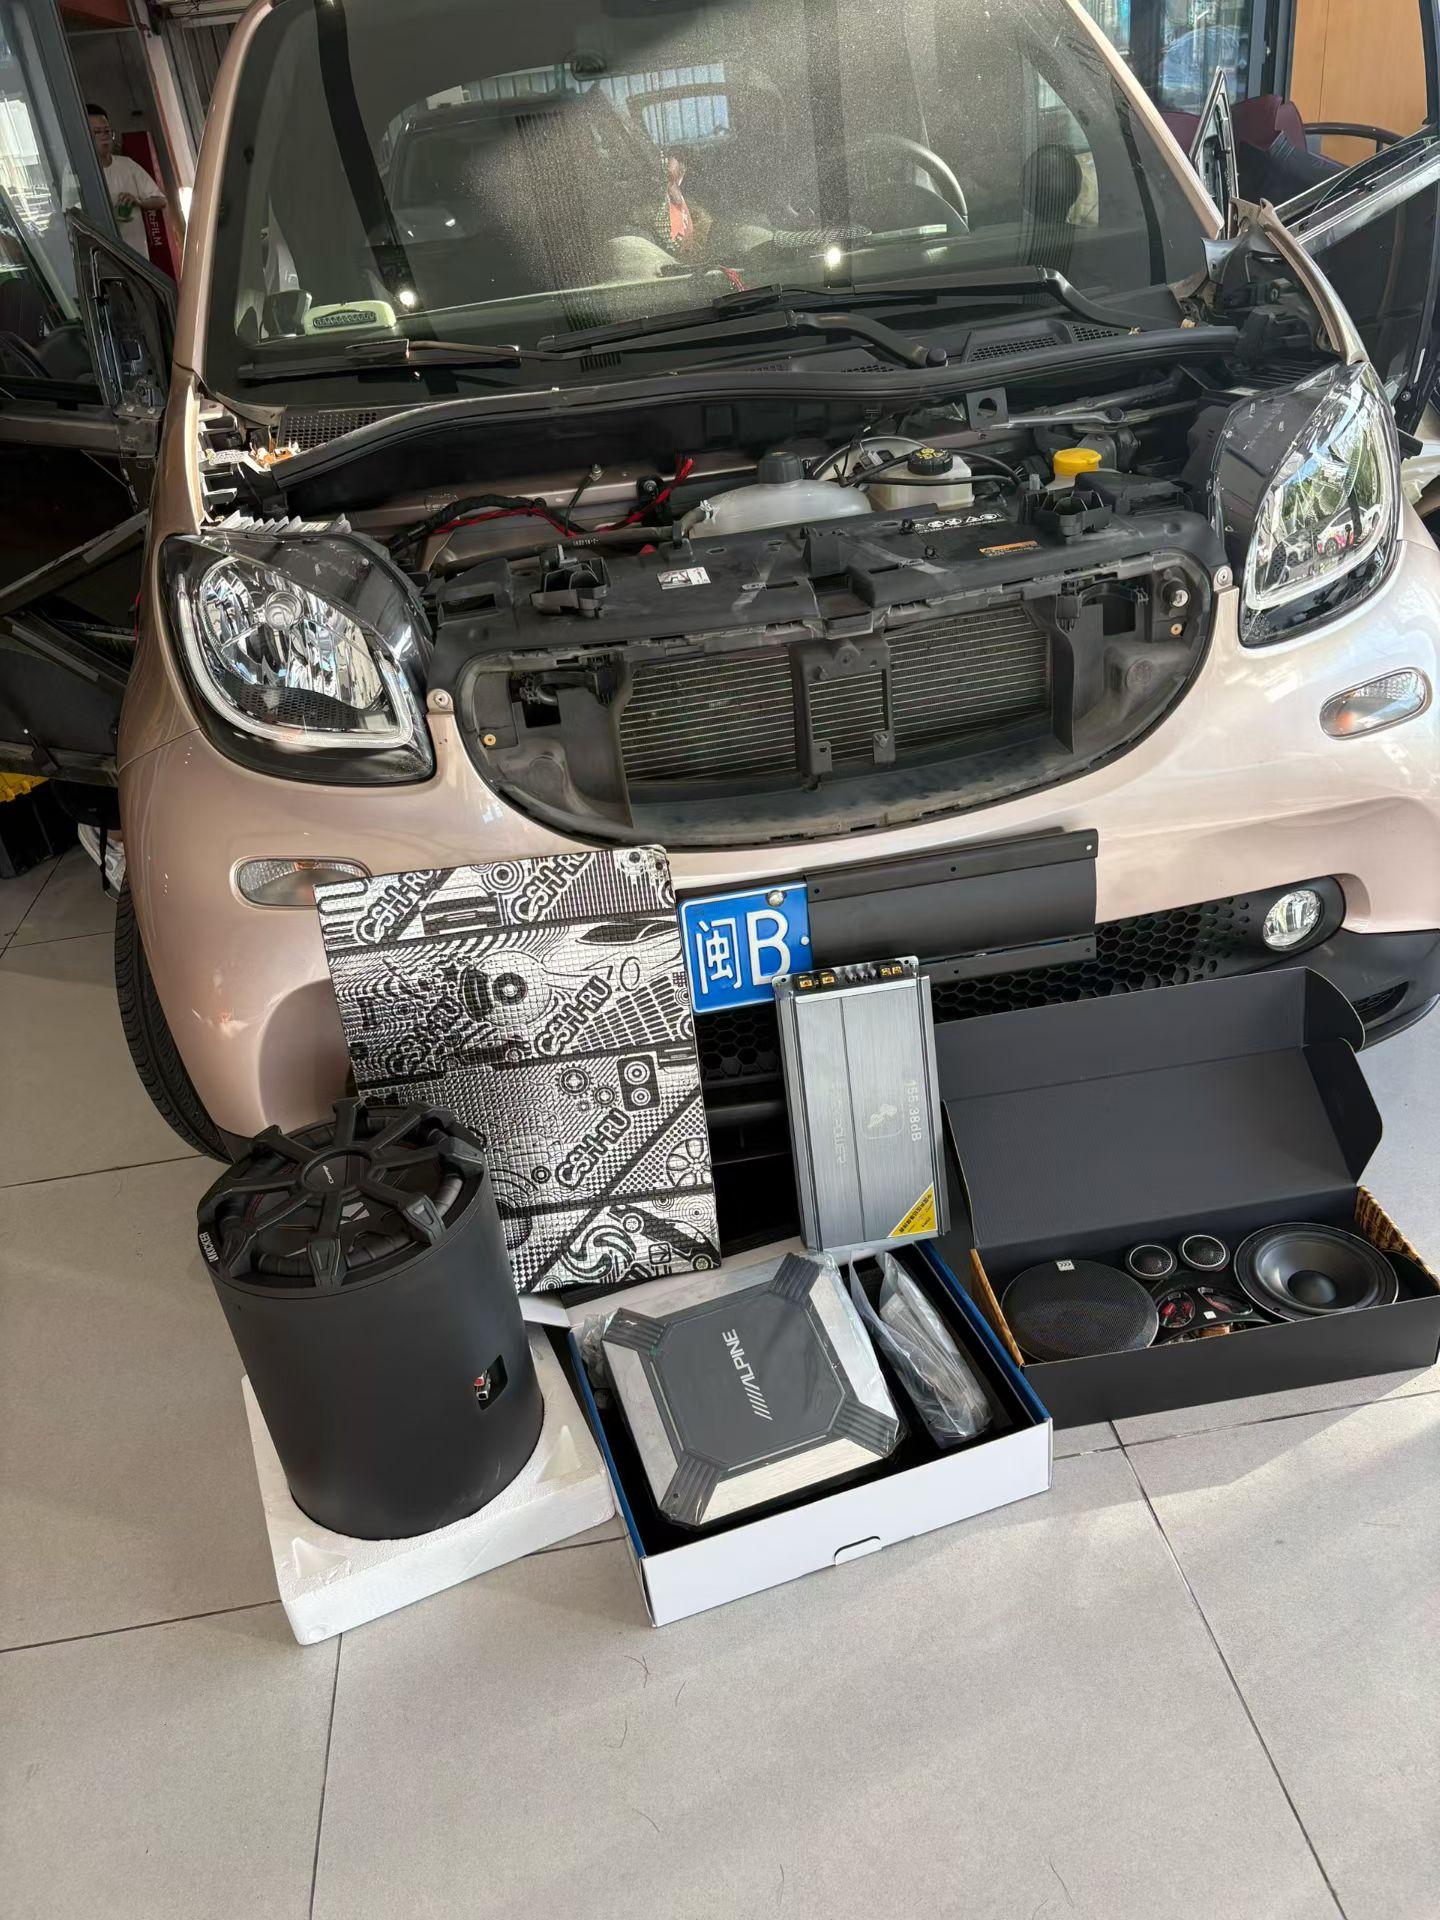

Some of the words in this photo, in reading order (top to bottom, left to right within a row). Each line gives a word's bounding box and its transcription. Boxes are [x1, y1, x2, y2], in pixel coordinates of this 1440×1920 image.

[537, 978, 609, 1055] CSH-RU
[556, 1109, 627, 1184] CSH-RU
[199, 1231, 217, 1258] KICKER
